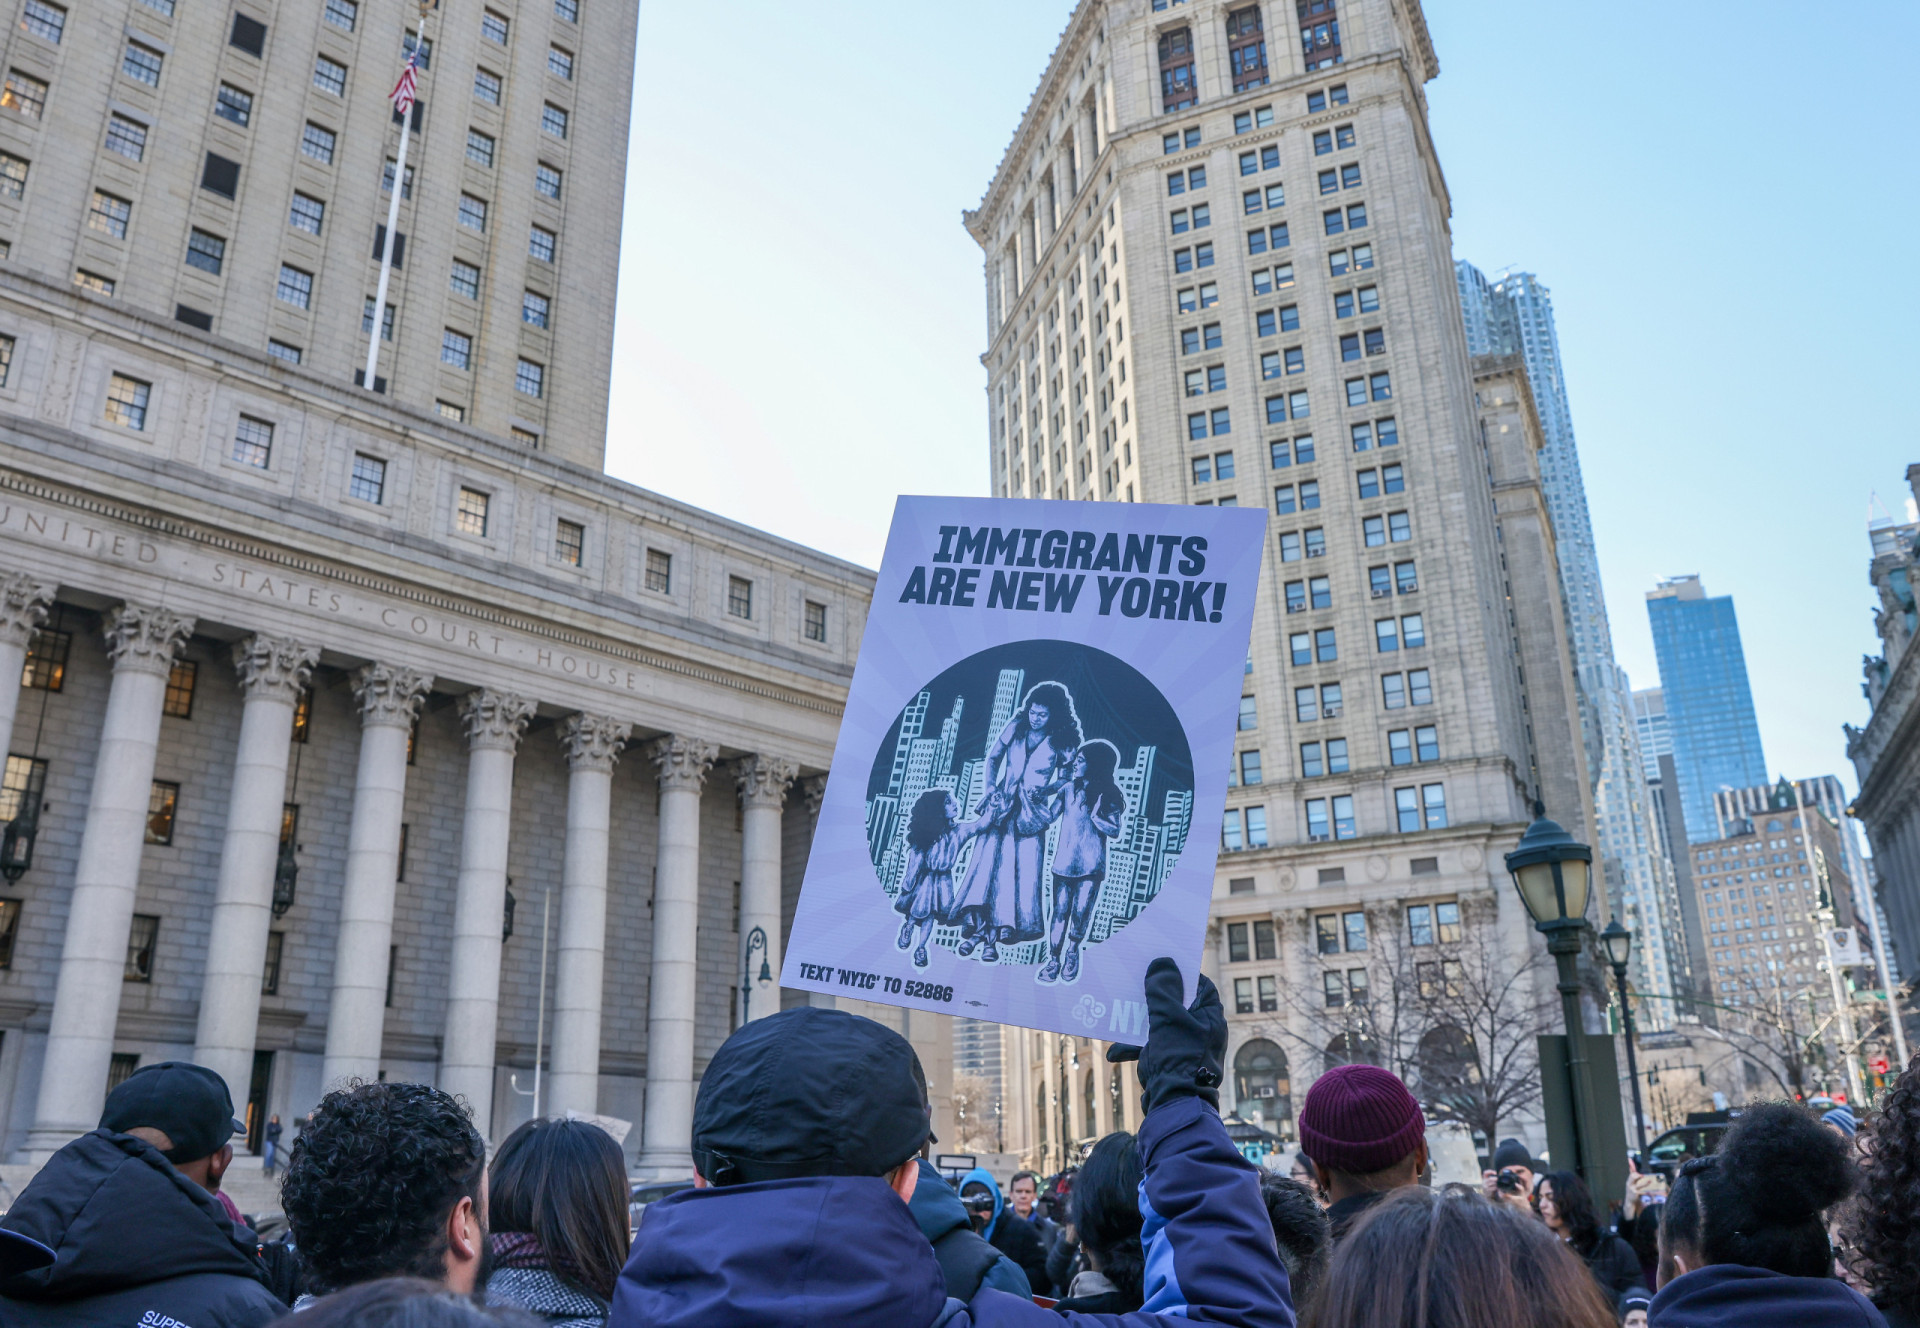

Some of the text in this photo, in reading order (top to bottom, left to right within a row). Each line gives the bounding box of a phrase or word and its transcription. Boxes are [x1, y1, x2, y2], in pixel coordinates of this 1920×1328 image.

[932, 525, 1208, 576] IMMIGRANTS
[898, 566, 1227, 624] ARE NEW YORK!
[213, 563, 341, 612] STATES
[382, 608, 504, 654] COURT
[537, 648, 635, 690] HOUSE
[800, 962, 954, 1003] TEXT 'NYIC' TO 52886
[1109, 999, 1148, 1036] NY
[142, 1310, 193, 1328] SUPE
